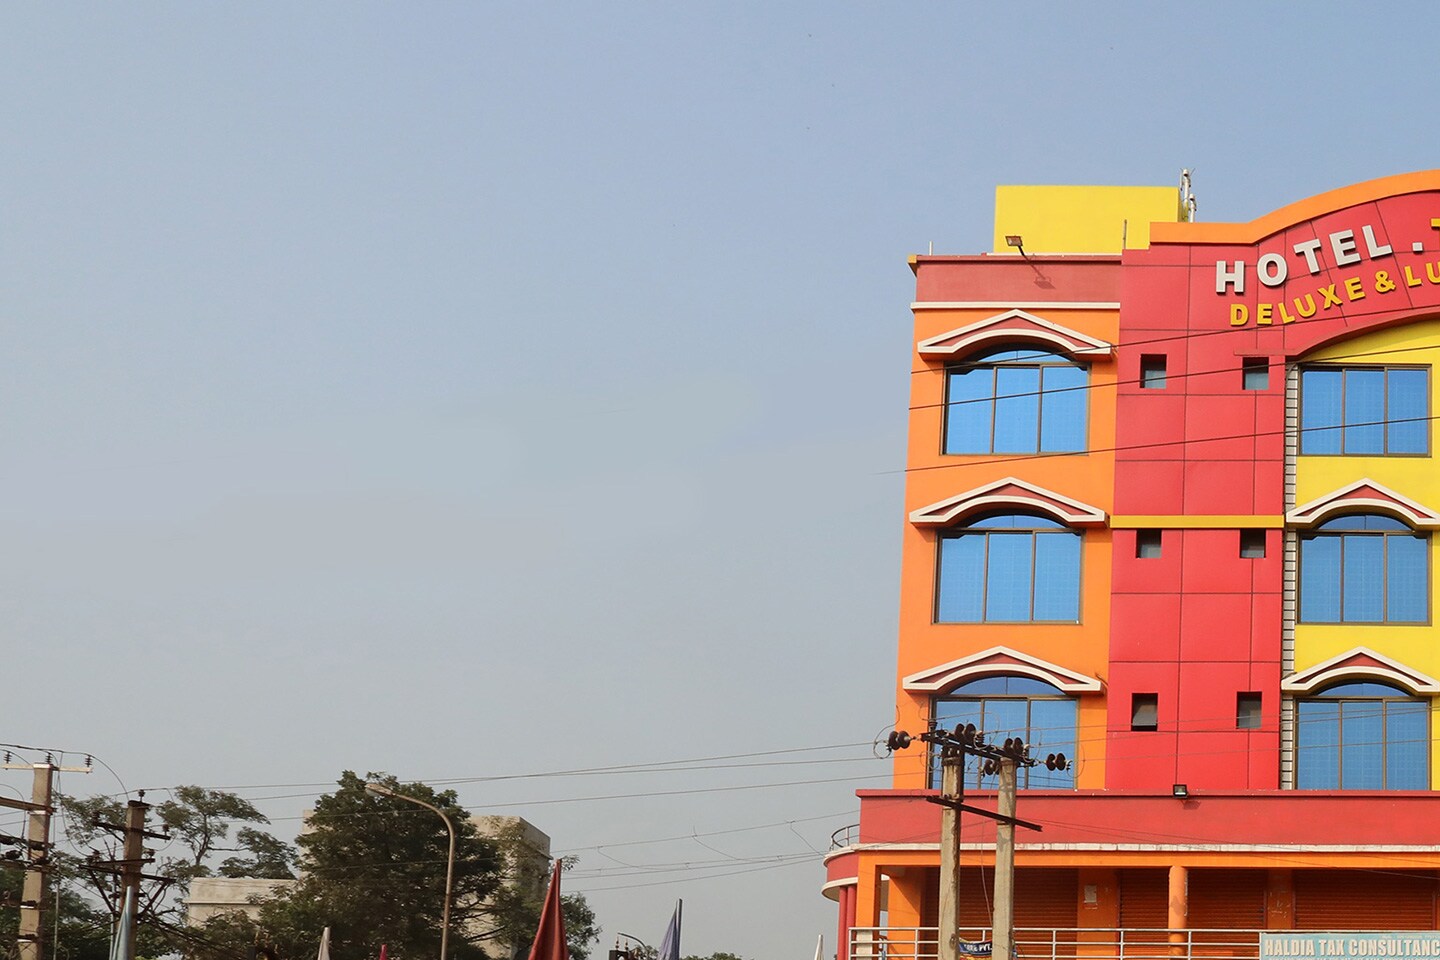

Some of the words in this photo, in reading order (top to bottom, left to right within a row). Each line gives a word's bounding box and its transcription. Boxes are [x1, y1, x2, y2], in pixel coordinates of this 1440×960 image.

[1215, 225, 1392, 293] HOTEL
[1229, 276, 1366, 326] DELUXE
[1374, 270, 1396, 293] &
[1265, 939, 1315, 956] HALDIA
[1319, 939, 1345, 956] TAX
